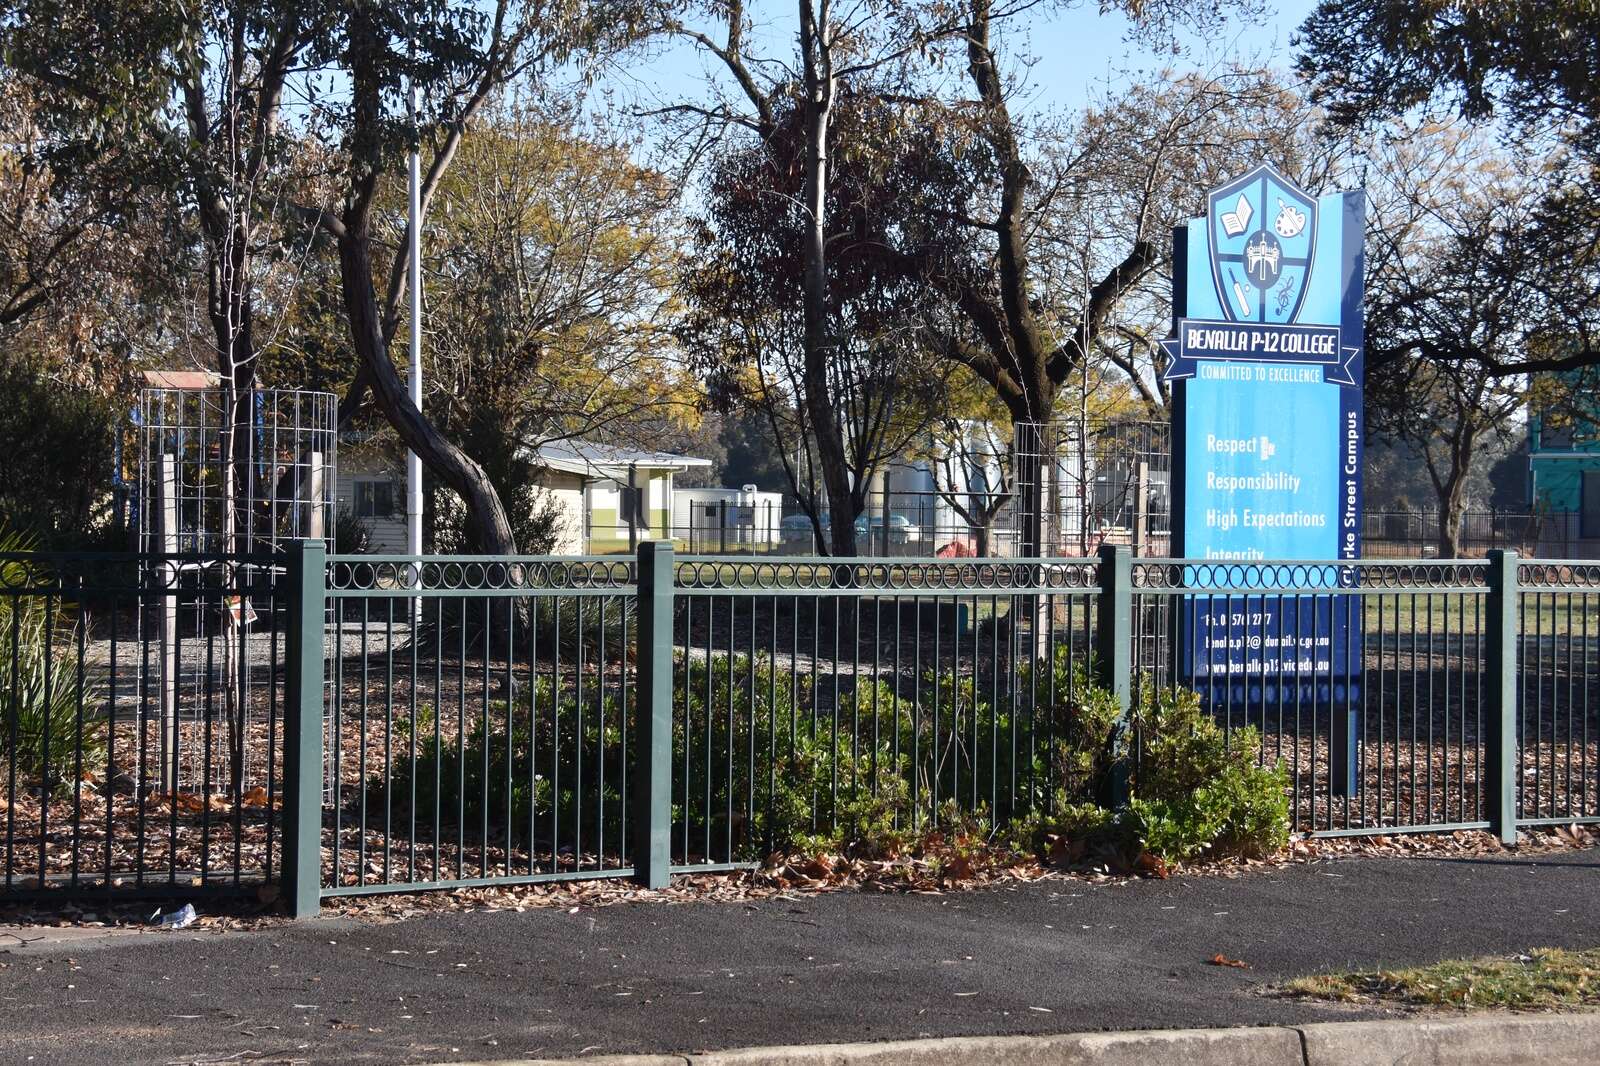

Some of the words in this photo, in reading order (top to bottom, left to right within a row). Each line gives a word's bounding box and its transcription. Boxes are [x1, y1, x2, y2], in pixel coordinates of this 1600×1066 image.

[1187, 329, 1248, 351] BENALLA
[1251, 332, 1280, 353] P-12
[1280, 333, 1336, 355] COLLEGE
[1201, 365, 1252, 381] COMMITTED
[1255, 366, 1266, 381] TO
[1269, 367, 1320, 383] EXCELLENCE
[1207, 434, 1256, 457] Respect
[1345, 412, 1360, 474] Campus
[1207, 472, 1300, 494] Responsibility
[1344, 480, 1356, 527] Street
[1206, 509, 1238, 531] High
[1243, 509, 1326, 531] Expectations
[1252, 613, 1272, 625] 277
